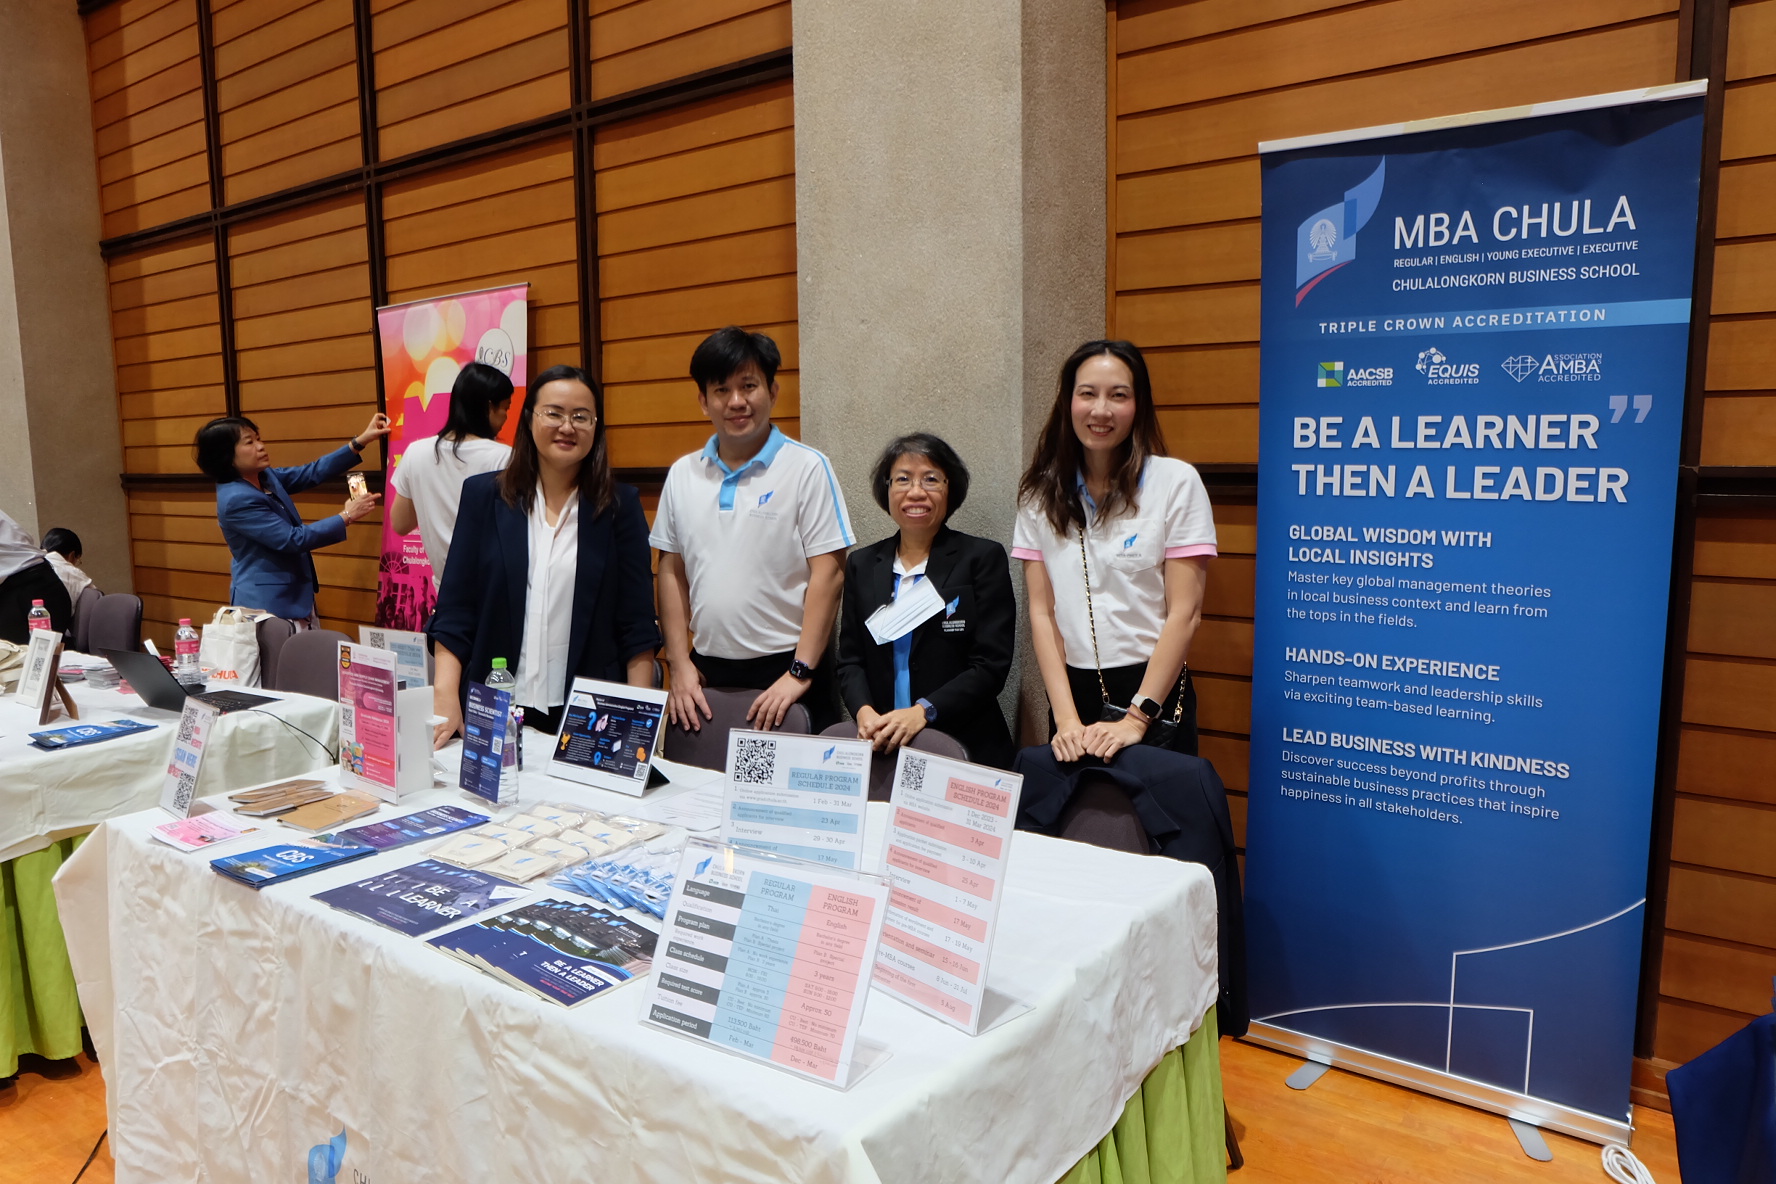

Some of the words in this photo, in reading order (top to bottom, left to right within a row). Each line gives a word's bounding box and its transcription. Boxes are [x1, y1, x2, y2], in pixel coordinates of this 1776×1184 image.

[1394, 210, 1478, 249] MBA
[1492, 195, 1636, 241] CHULA
[1394, 256, 1433, 268] REGULAR
[1440, 253, 1479, 265] ENGLISH
[1487, 250, 1519, 261] YOUNG
[1522, 246, 1574, 258] EXECUTIVE
[1583, 241, 1638, 253] EXECUTIVE
[1392, 273, 1505, 291] CHULALONGKORN
[1509, 268, 1576, 283] BUSINESS
[1580, 263, 1639, 279] SCHOOL
[1319, 322, 1377, 334] TRIPLE
[1384, 317, 1445, 330] CROWN
[1453, 309, 1607, 328] ACCREDITATION
[1347, 368, 1393, 380] AACSB
[1428, 364, 1479, 378] EQUIS
[1538, 374, 1600, 382] ACCREDITED
[1293, 417, 1342, 449] BE
[1352, 417, 1380, 448] A
[1391, 415, 1599, 449] LEARNER
[1292, 464, 1396, 497] THEN
[1405, 466, 1434, 498] A
[1446, 466, 1629, 503] LEADER
[1289, 525, 1358, 542] GLOBAL
[1362, 528, 1436, 545] WISDOM
[1442, 530, 1492, 547] WITH
[1288, 547, 1345, 564] LOCAL
[1350, 550, 1433, 568] INSIGHTS
[1288, 571, 1329, 584] Master
[1332, 573, 1353, 587] key
[1356, 574, 1395, 589] global
[1398, 578, 1487, 594] management
[1491, 583, 1551, 598] theories
[1287, 589, 1298, 600] in
[1301, 590, 1329, 602] local
[1333, 592, 1388, 607] business
[1392, 596, 1441, 611] context
[1445, 599, 1470, 612] and
[1474, 601, 1509, 615] learn
[1513, 603, 1548, 618] from
[1287, 608, 1306, 619] the
[1309, 609, 1337, 622] tops
[1340, 611, 1351, 622] in
[1354, 611, 1375, 624] the
[1378, 613, 1417, 628] fields.
[1285, 647, 1377, 669] HANDS-ON
[1381, 656, 1500, 681] EXPERIENCE
[1284, 670, 1335, 686] Sharpen
[1338, 676, 1400, 693] teamwork
[1403, 683, 1427, 696] and
[1431, 686, 1503, 705] leadership
[1507, 694, 1543, 708] skills
[1284, 689, 1300, 700] via
[1304, 691, 1352, 707] exciting
[1356, 696, 1432, 716] team-based
[1436, 705, 1495, 724] learning.
[1283, 728, 1326, 746] LEAD
[1330, 733, 1415, 758] BUSINESS
[1420, 744, 1466, 766] WITH
[1471, 752, 1570, 778] KINDNESS
[825, 775, 858, 784] PROGRAM
[1282, 750, 1334, 767] Discover
[1337, 759, 1387, 775] success
[1390, 765, 1436, 783] beyond
[1440, 773, 1486, 790] profits
[1489, 780, 1545, 799] through
[798, 781, 833, 789] SCHEDULE
[950, 782, 975, 794] ENGLISH
[977, 789, 1006, 803] PROGRAM
[1281, 769, 1350, 787] sustainable
[1354, 778, 1408, 797] business
[1412, 788, 1474, 807] practices
[1478, 796, 1507, 811] that
[1510, 801, 1559, 820] inspire
[953, 792, 985, 807] SCHEDULE
[985, 800, 999, 810] 2024
[1281, 785, 1341, 804] happiness
[1345, 795, 1355, 805] in
[1358, 797, 1372, 809] all
[1375, 800, 1463, 824] stakeholders.
[425, 885, 450, 897] BE
[687, 885, 710, 897] Language
[761, 888, 794, 901] PROGRAM
[764, 879, 795, 892] REGULAR
[400, 892, 461, 919] LEARNER
[768, 905, 779, 913] Thai
[823, 902, 858, 916] PROGRAM
[828, 894, 858, 906] ENGLISH
[678, 915, 698, 926] Program
[826, 920, 847, 930] English
[670, 946, 682, 956] Class
[683, 951, 704, 962] schedule
[540, 961, 558, 973] THEN
[566, 974, 595, 991] LEADER
[571, 968, 604, 987] LEARNER
[661, 978, 681, 989] Required
[819, 973, 834, 982] years
[653, 1009, 680, 1024] Application
[681, 1020, 697, 1029] period
[744, 1040, 753, 1048] Mar
[813, 1044, 827, 1053] Baht
[791, 1055, 801, 1064] Dec
[806, 1061, 818, 1069] Mar
